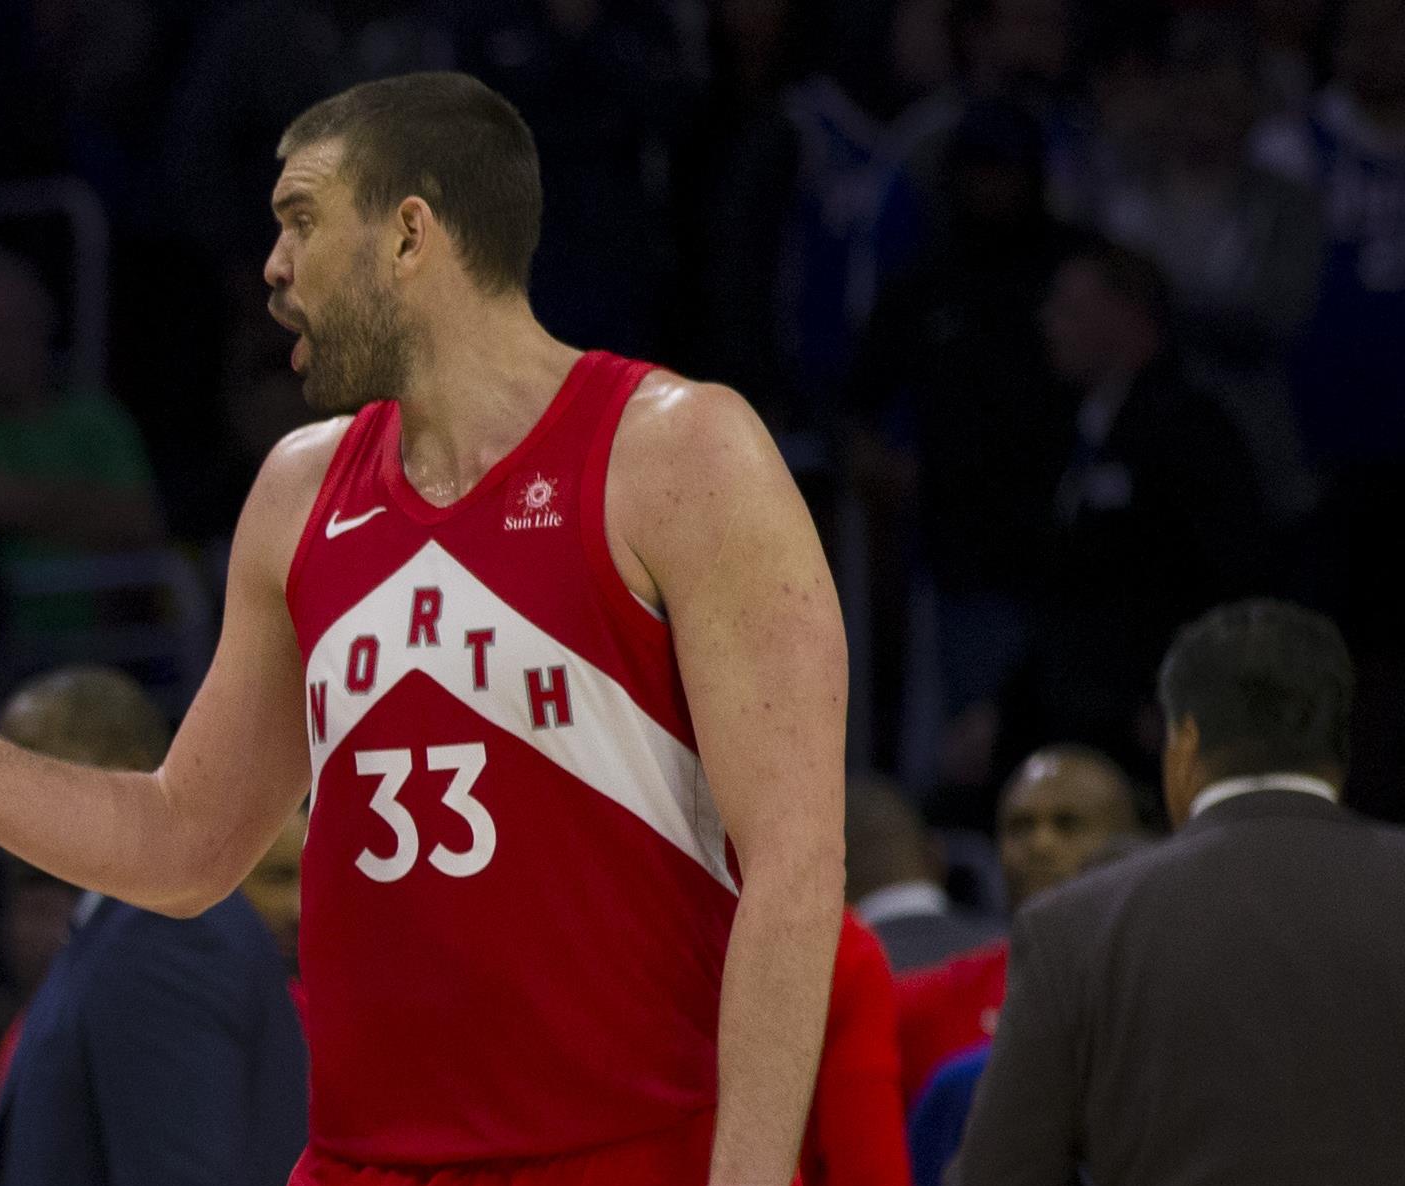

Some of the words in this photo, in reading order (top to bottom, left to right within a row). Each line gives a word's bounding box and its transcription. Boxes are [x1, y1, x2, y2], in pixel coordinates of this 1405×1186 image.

[503, 515, 532, 531] Sun
[534, 511, 563, 528] Life
[309, 586, 573, 744] NORTH
[354, 742, 496, 883] 33
